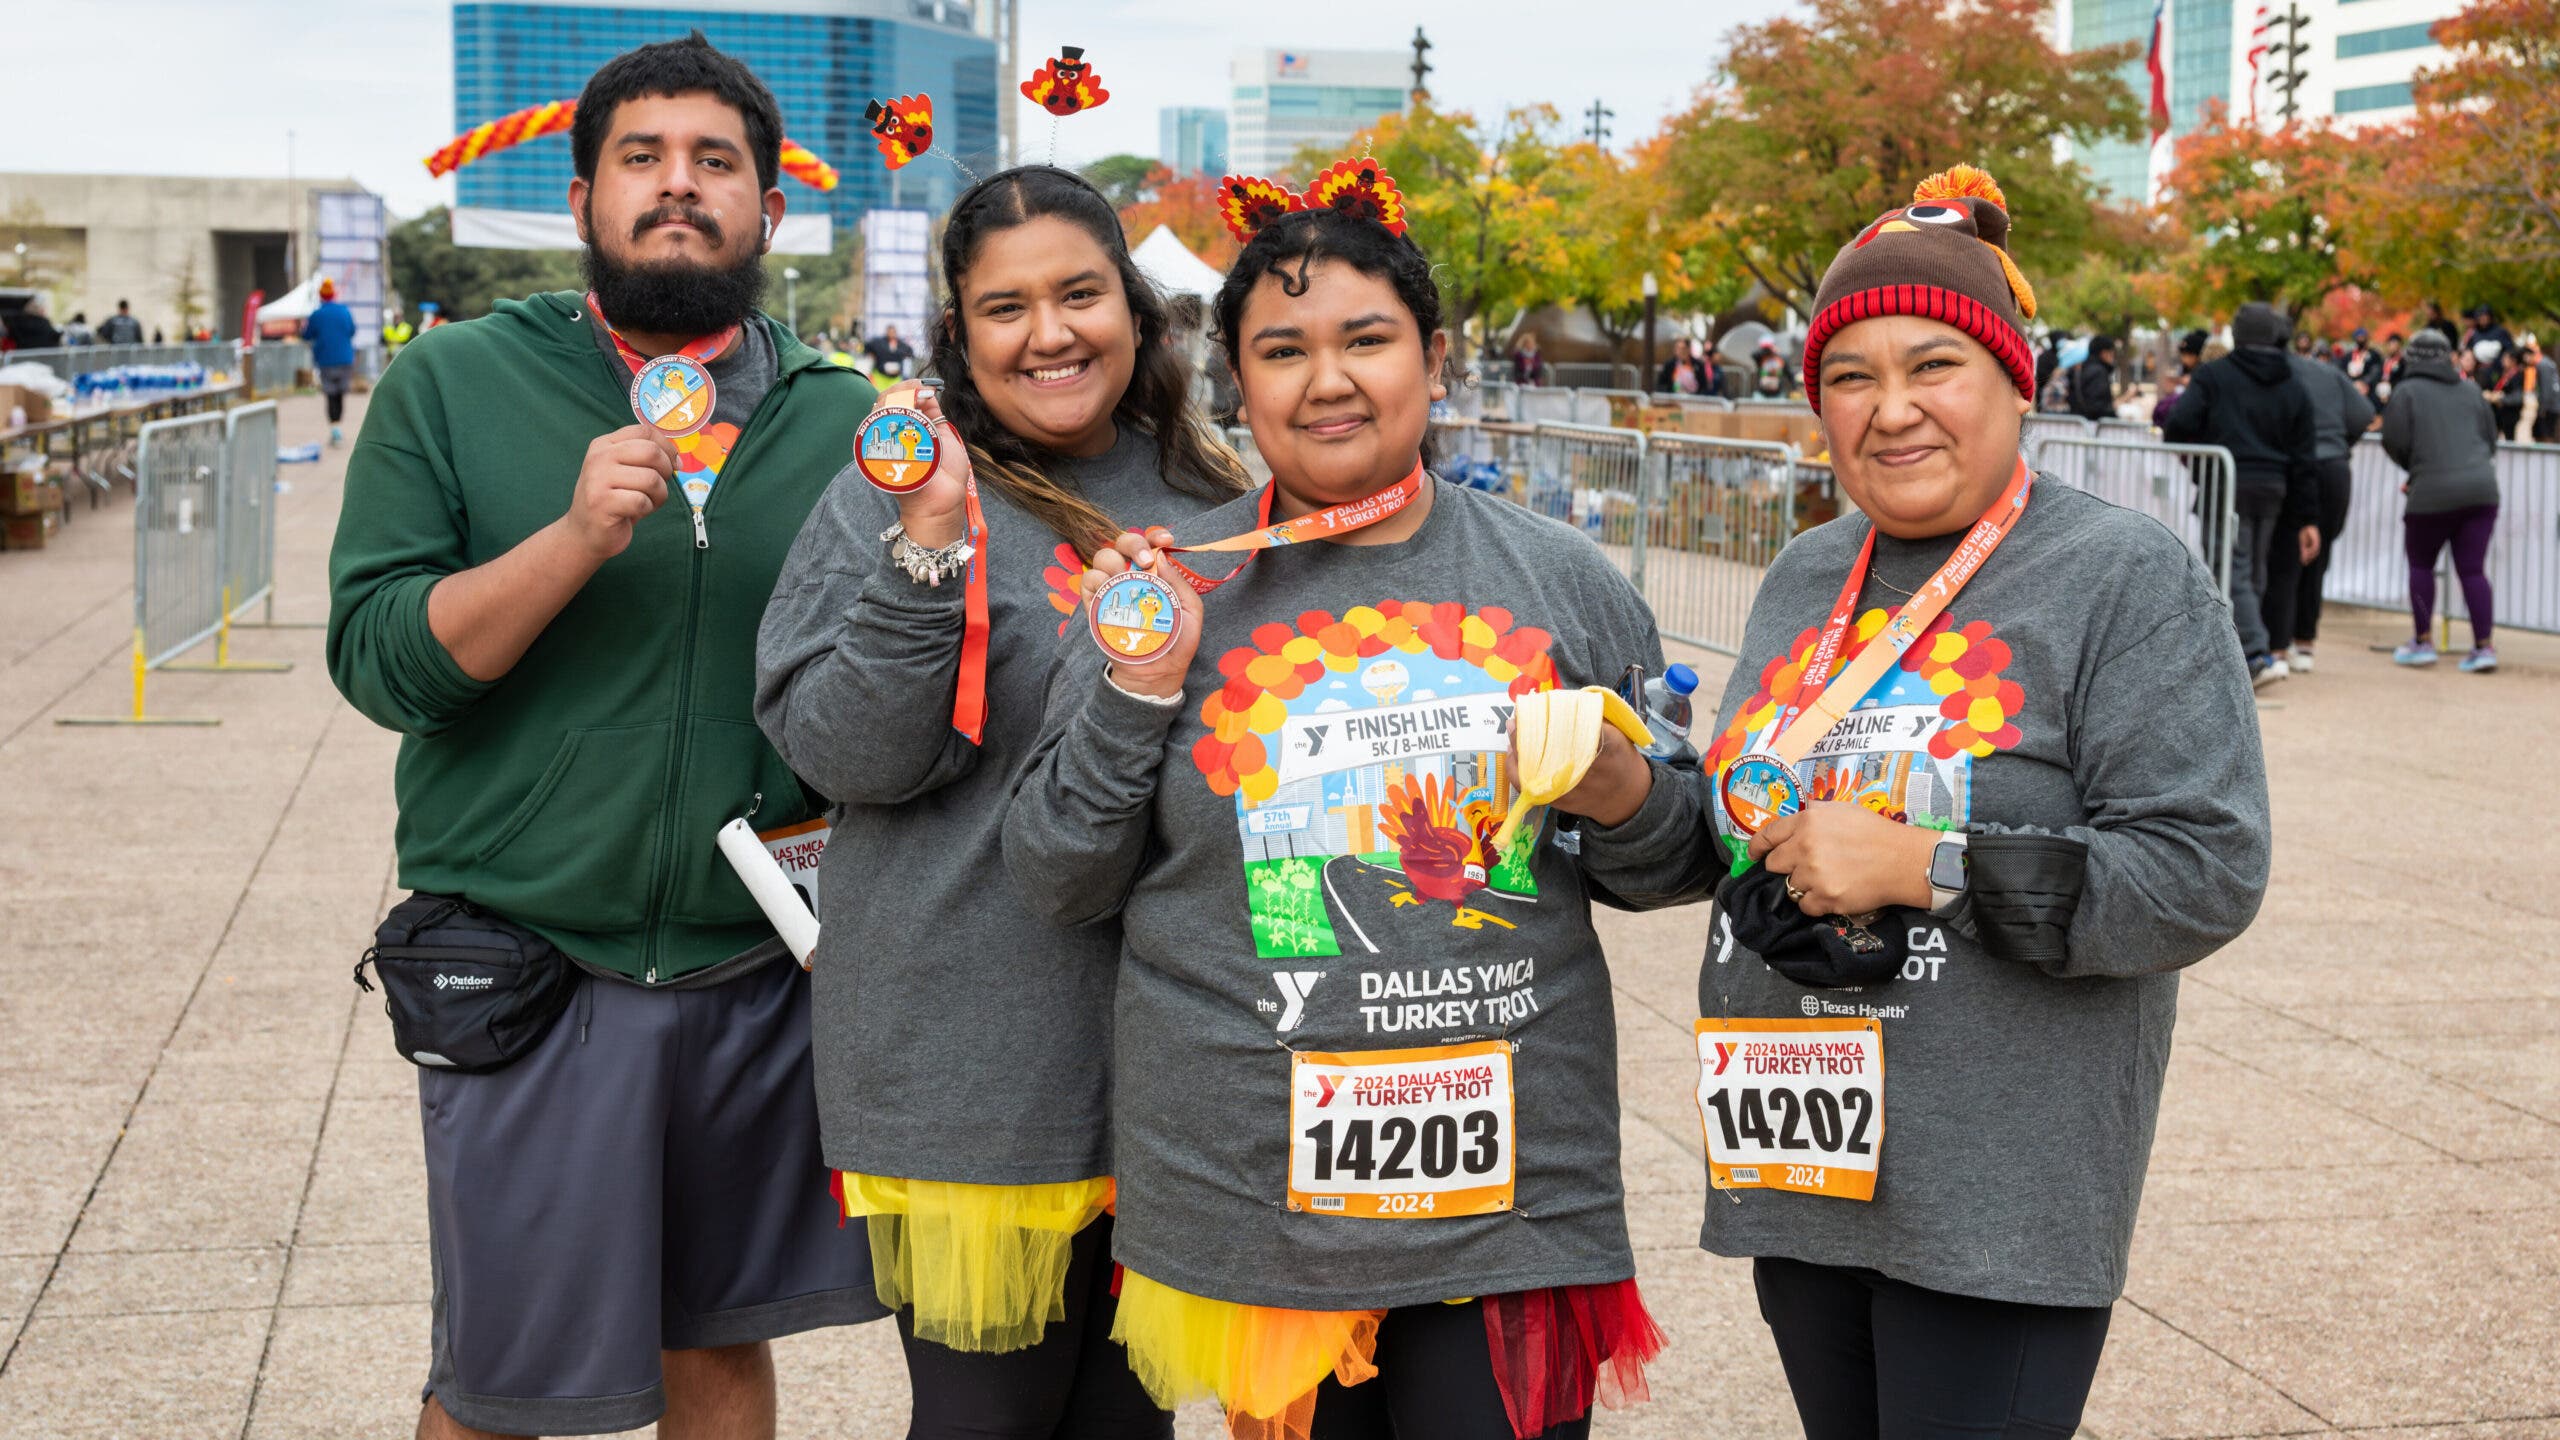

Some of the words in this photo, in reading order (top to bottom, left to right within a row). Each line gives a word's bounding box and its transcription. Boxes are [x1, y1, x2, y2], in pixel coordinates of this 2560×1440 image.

[867, 409, 888, 424] DALLAS
[925, 423, 938, 439] TROT
[1336, 497, 1376, 517] DALLAS
[1375, 486, 1405, 504] YMCA
[1340, 506, 1380, 528] TURKEY
[1382, 495, 1406, 513] TROT
[1944, 544, 1973, 577] DALLAS
[1969, 520, 1993, 545] YMCA
[1950, 550, 1983, 586] TURKEY
[1979, 525, 2001, 552] TROT
[1132, 573, 1149, 581] YMCA
[1910, 594, 1927, 611] 57th
[1813, 629, 1834, 663] TURKEY
[1824, 627, 1844, 660] DALLAS
[1802, 663, 1820, 686] TROT
[1812, 661, 1832, 686] YMCA
[1345, 712, 1417, 741] FINISH
[1421, 706, 1471, 732] LINE
[1856, 715, 1895, 735] LINE
[1295, 741, 1307, 749] the
[1372, 740, 1390, 757] 5K
[1393, 740, 1399, 755] /
[1402, 733, 1450, 752] 8-MILE
[1813, 740, 1827, 753] 5K
[1835, 737, 1871, 751] 8-MILE
[1764, 757, 1782, 768] YMCA
[1472, 790, 1490, 798] 2024
[1264, 811, 1290, 823] 57th
[1265, 821, 1292, 830] Annual
[794, 839, 825, 856] YMCA
[787, 851, 821, 872] TRO
[1907, 926, 1948, 951] CA
[1360, 967, 1473, 1000] DALLAS
[1476, 957, 1534, 993] YMCA
[1895, 956, 1947, 981] OT
[449, 975, 493, 985] Outdoor
[1257, 998, 1278, 1012] the
[1359, 999, 1480, 1033] TURKEY
[1484, 986, 1539, 1026] TROT
[1821, 1000, 1856, 1015] Texas
[1859, 1003, 1905, 1019] Health
[1744, 1043, 1777, 1057] 2024
[1780, 1043, 1823, 1057] DALLAS
[1825, 1042, 1864, 1056] YMCA
[1743, 1057, 1815, 1075] TURKEY
[1815, 1056, 1865, 1075] TROT
[1353, 1075, 1394, 1090] 2024
[1398, 1070, 1451, 1087] DALLAS
[1454, 1065, 1493, 1082] YMCA
[1304, 1090, 1317, 1098] the
[1353, 1086, 1437, 1107] TURKEY
[1442, 1079, 1494, 1101] TROT
[1707, 1087, 1873, 1155] 14202
[1305, 1109, 1499, 1181] 14203
[1785, 1166, 1825, 1188] 2024
[1376, 1193, 1435, 1214] 2024
